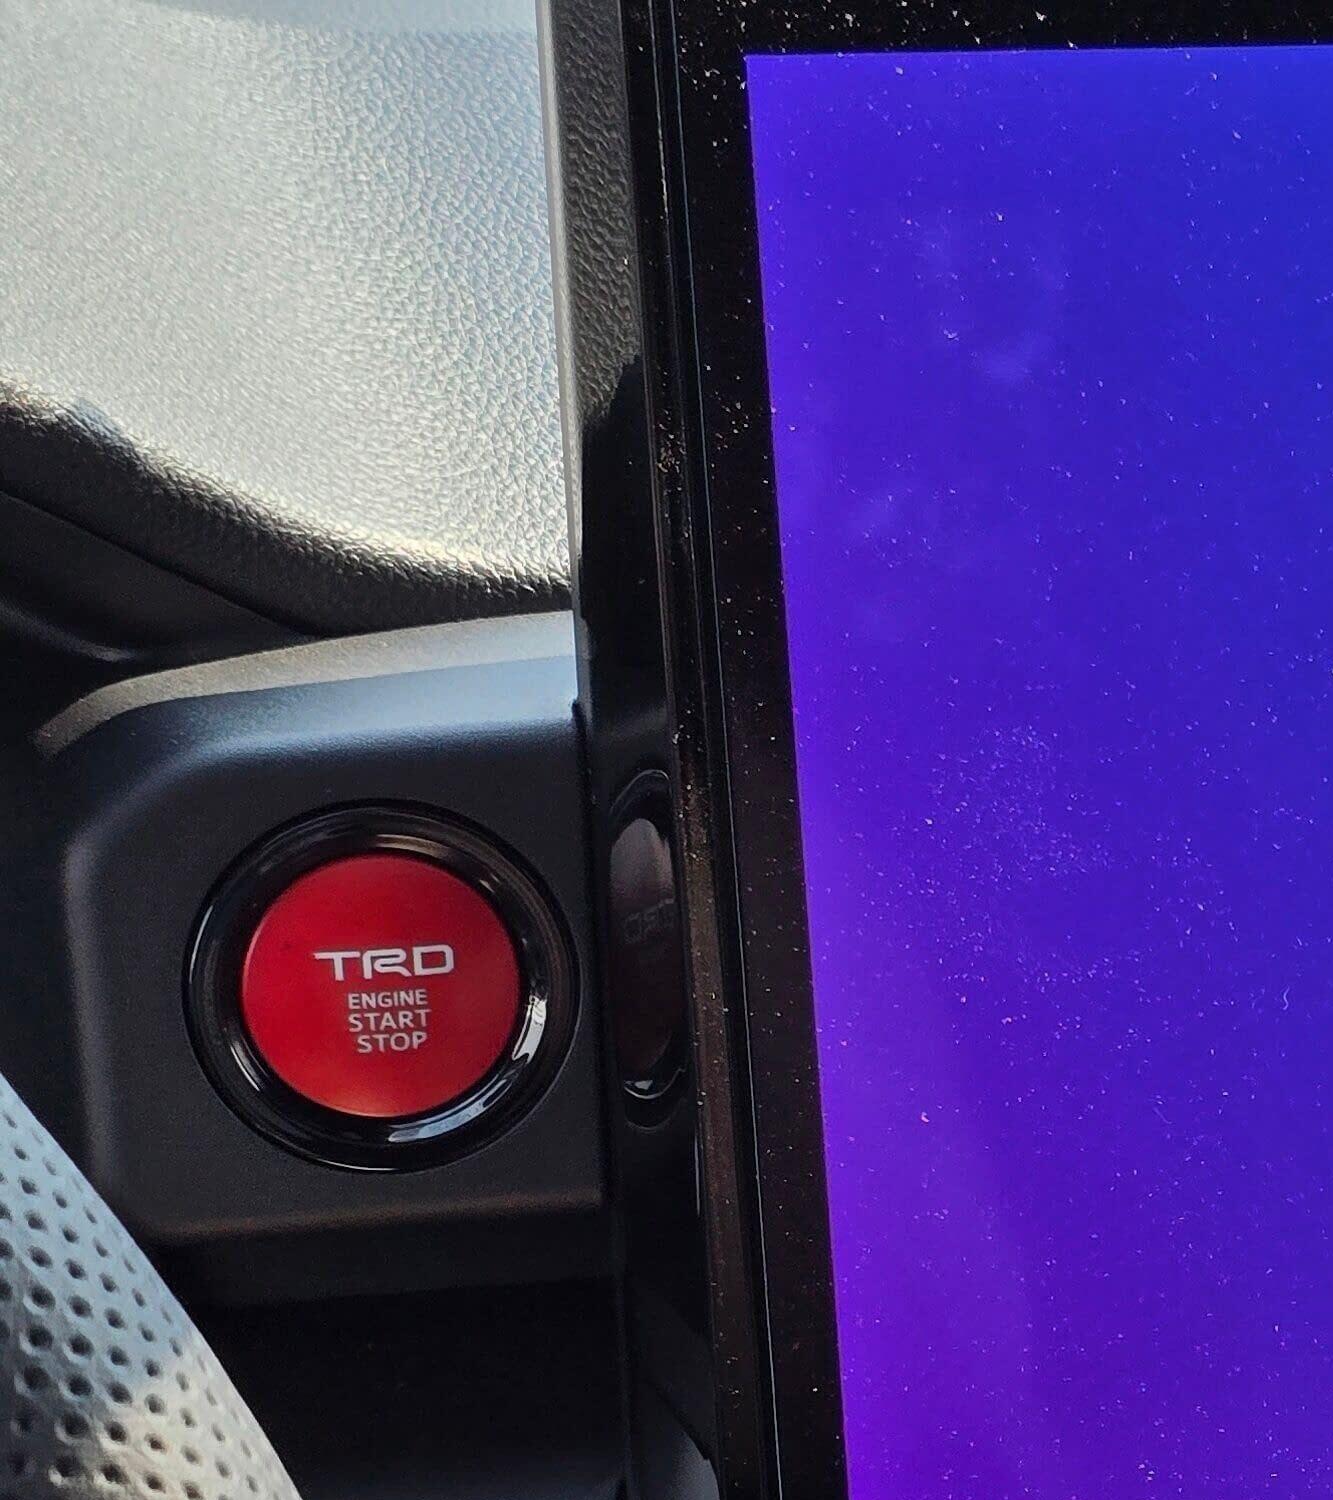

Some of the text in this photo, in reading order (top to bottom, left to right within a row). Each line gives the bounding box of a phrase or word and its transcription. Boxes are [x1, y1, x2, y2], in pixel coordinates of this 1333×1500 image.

[313, 944, 455, 981] TRD
[347, 988, 429, 1010] ENGINE
[348, 1008, 431, 1032] START
[357, 1031, 428, 1053] STOP
